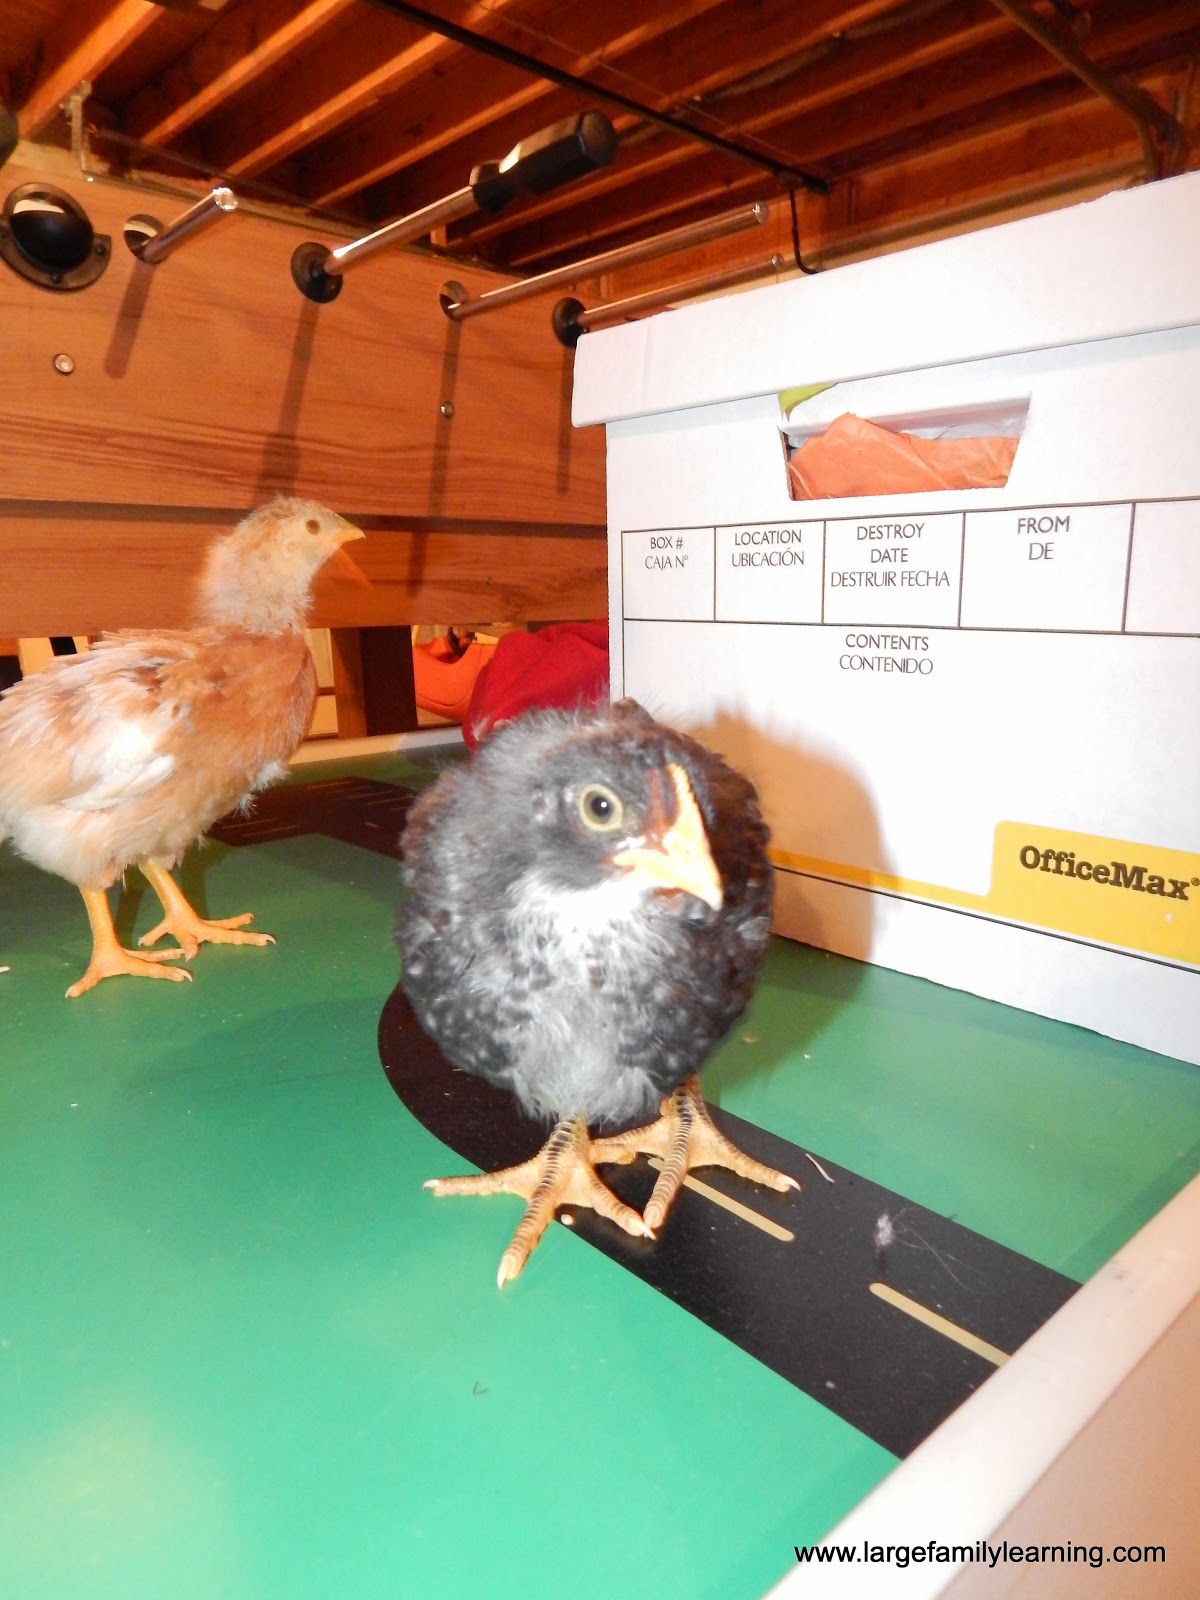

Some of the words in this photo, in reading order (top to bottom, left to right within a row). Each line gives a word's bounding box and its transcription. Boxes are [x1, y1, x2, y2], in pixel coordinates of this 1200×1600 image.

[856, 522, 925, 541] DESTROY
[1017, 515, 1071, 534] FROM
[650, 536, 674, 550] BOX
[676, 536, 684, 549] #
[734, 529, 802, 546] LOCATION
[731, 547, 805, 568] UBICACIÓN
[870, 547, 909, 564] DATE
[1028, 542, 1055, 561] DE
[644, 556, 673, 571] CAJA
[830, 570, 897, 588] DESTRUIR
[900, 570, 951, 587] FECHA
[845, 633, 929, 652] CONTENTS
[839, 654, 934, 675] CONTENIDO
